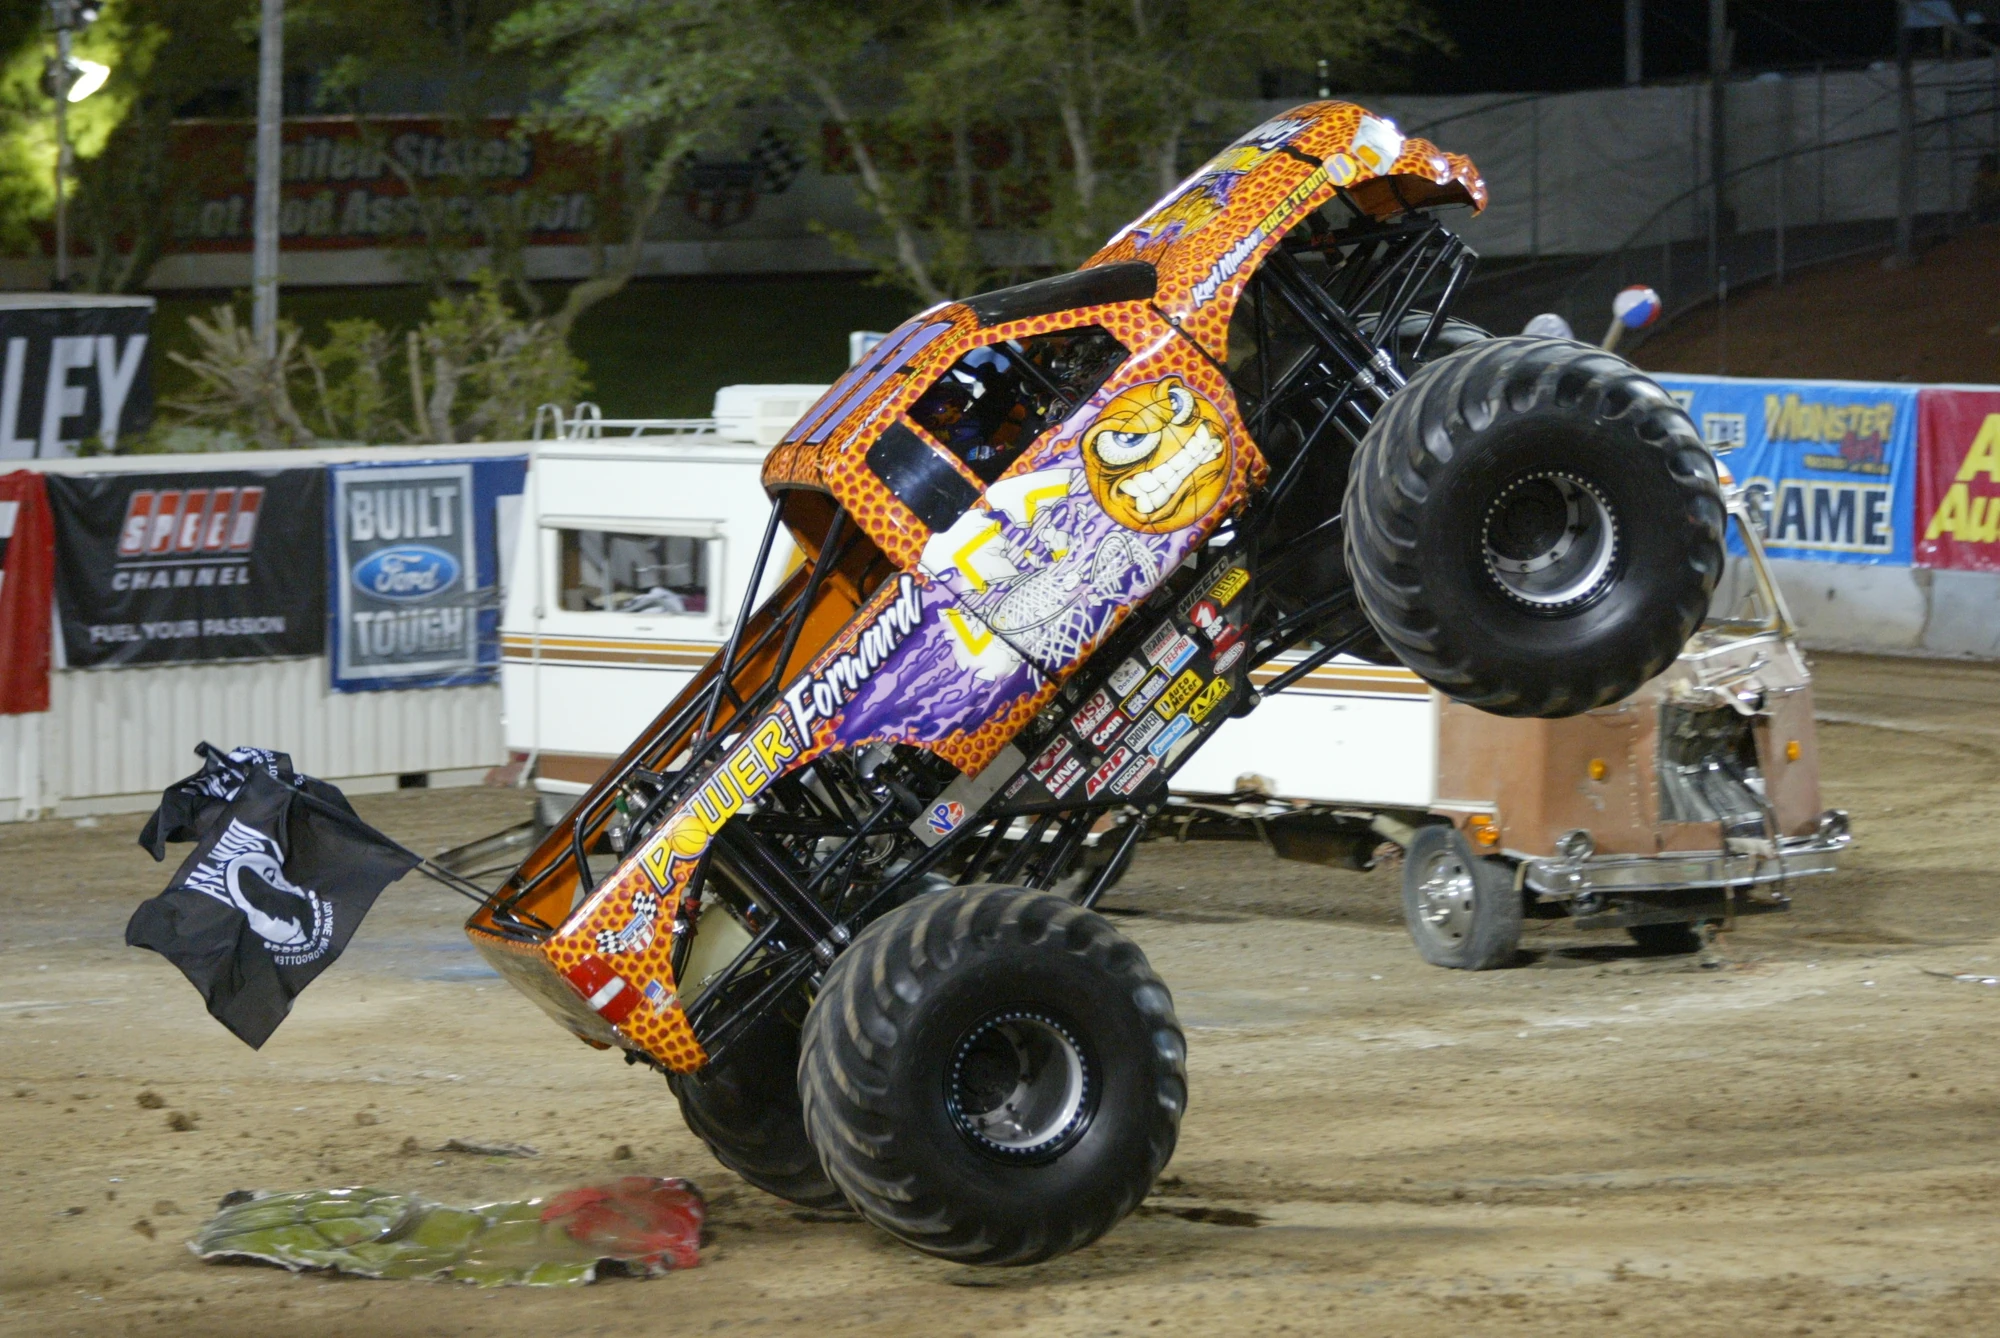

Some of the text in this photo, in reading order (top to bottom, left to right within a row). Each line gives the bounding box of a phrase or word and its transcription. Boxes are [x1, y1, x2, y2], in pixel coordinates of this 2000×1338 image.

[1259, 200, 1294, 237] RACE
[1290, 166, 1328, 203] TEAM
[119, 500, 263, 556] SPEED
[350, 486, 457, 541] BUILT
[1744, 480, 1893, 552] GAME
[112, 566, 250, 591] CHANNEL
[373, 553, 440, 592] Ford
[1179, 557, 1229, 615] WISECO
[1211, 569, 1241, 598] DEIST
[90, 616, 286, 643] FUEL YOUR PASSION
[352, 606, 464, 657] TOUGH
[784, 575, 922, 748] Forward
[1117, 666, 1141, 692] Dossier
[1168, 677, 1190, 701] Auto
[1172, 679, 1198, 711] Meter
[1072, 693, 1106, 730] MSD
[1127, 712, 1160, 747] CROWER
[1092, 716, 1124, 746] Coan
[1029, 737, 1068, 776] WORLD
[1045, 757, 1080, 793] KING
[1086, 747, 1126, 796] ARP
[1112, 757, 1145, 792] LINCOLN
[641, 716, 797, 892] POWER
[928, 803, 955, 832] VP
